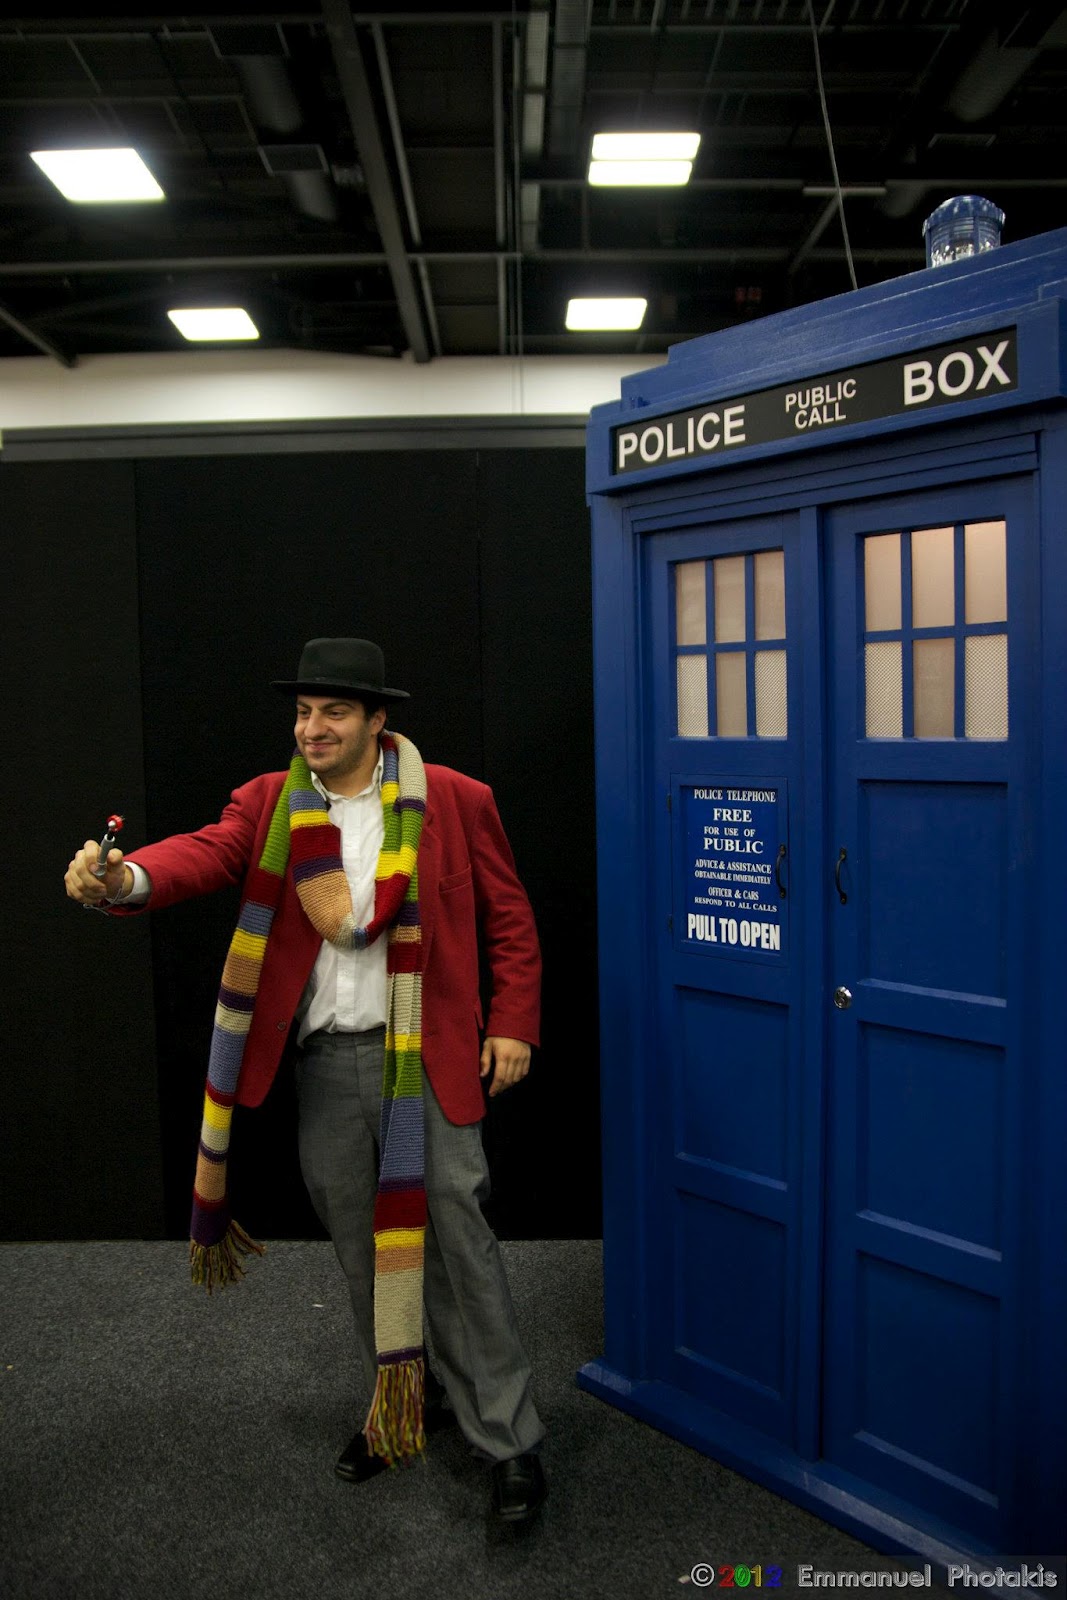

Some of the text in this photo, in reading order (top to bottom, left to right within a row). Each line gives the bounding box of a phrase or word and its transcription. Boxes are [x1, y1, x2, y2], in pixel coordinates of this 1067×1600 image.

[903, 340, 1011, 405] BOX
[785, 378, 857, 413] PUBLIC
[794, 402, 846, 429] CALL
[618, 405, 746, 468] POLICE
[694, 789, 776, 802] POLICE TELEPHONE
[713, 808, 752, 822] FREE
[704, 826, 756, 837] FOR USE OF
[704, 838, 763, 854] PUBLIC
[695, 859, 772, 874] ADVICE & ASSISTANCE
[695, 871, 771, 884] OBTAINABLE IMMEDIATELY
[708, 887, 759, 900] OFFICER & CARS
[695, 897, 722, 906] RESPOND
[726, 900, 735, 908] TO
[753, 904, 777, 912] CALLS
[688, 913, 780, 950] PULL TO OPEN
